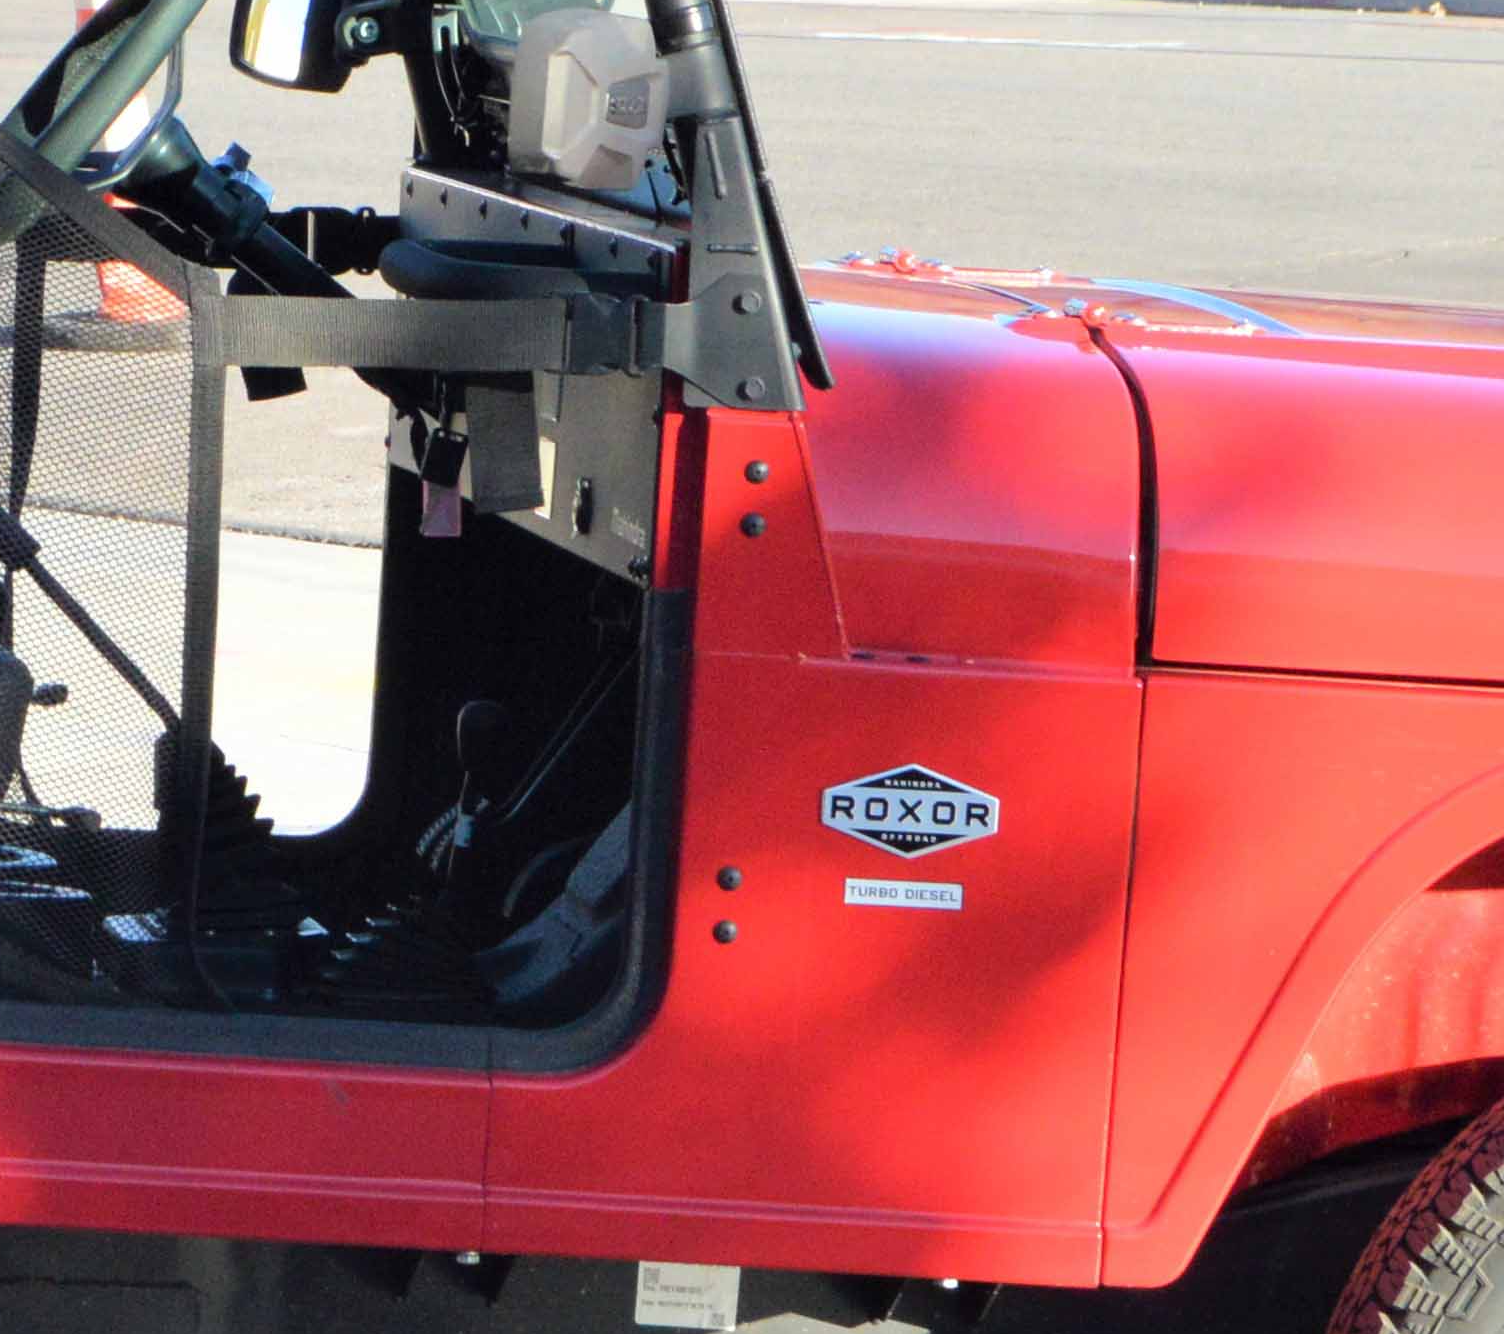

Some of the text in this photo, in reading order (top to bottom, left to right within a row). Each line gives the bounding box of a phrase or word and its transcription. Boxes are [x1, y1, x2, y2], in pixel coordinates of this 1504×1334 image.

[884, 779, 942, 790] MAHINDRA
[830, 795, 990, 827] ROXOR
[849, 885, 959, 903] TURBO DIESEL
